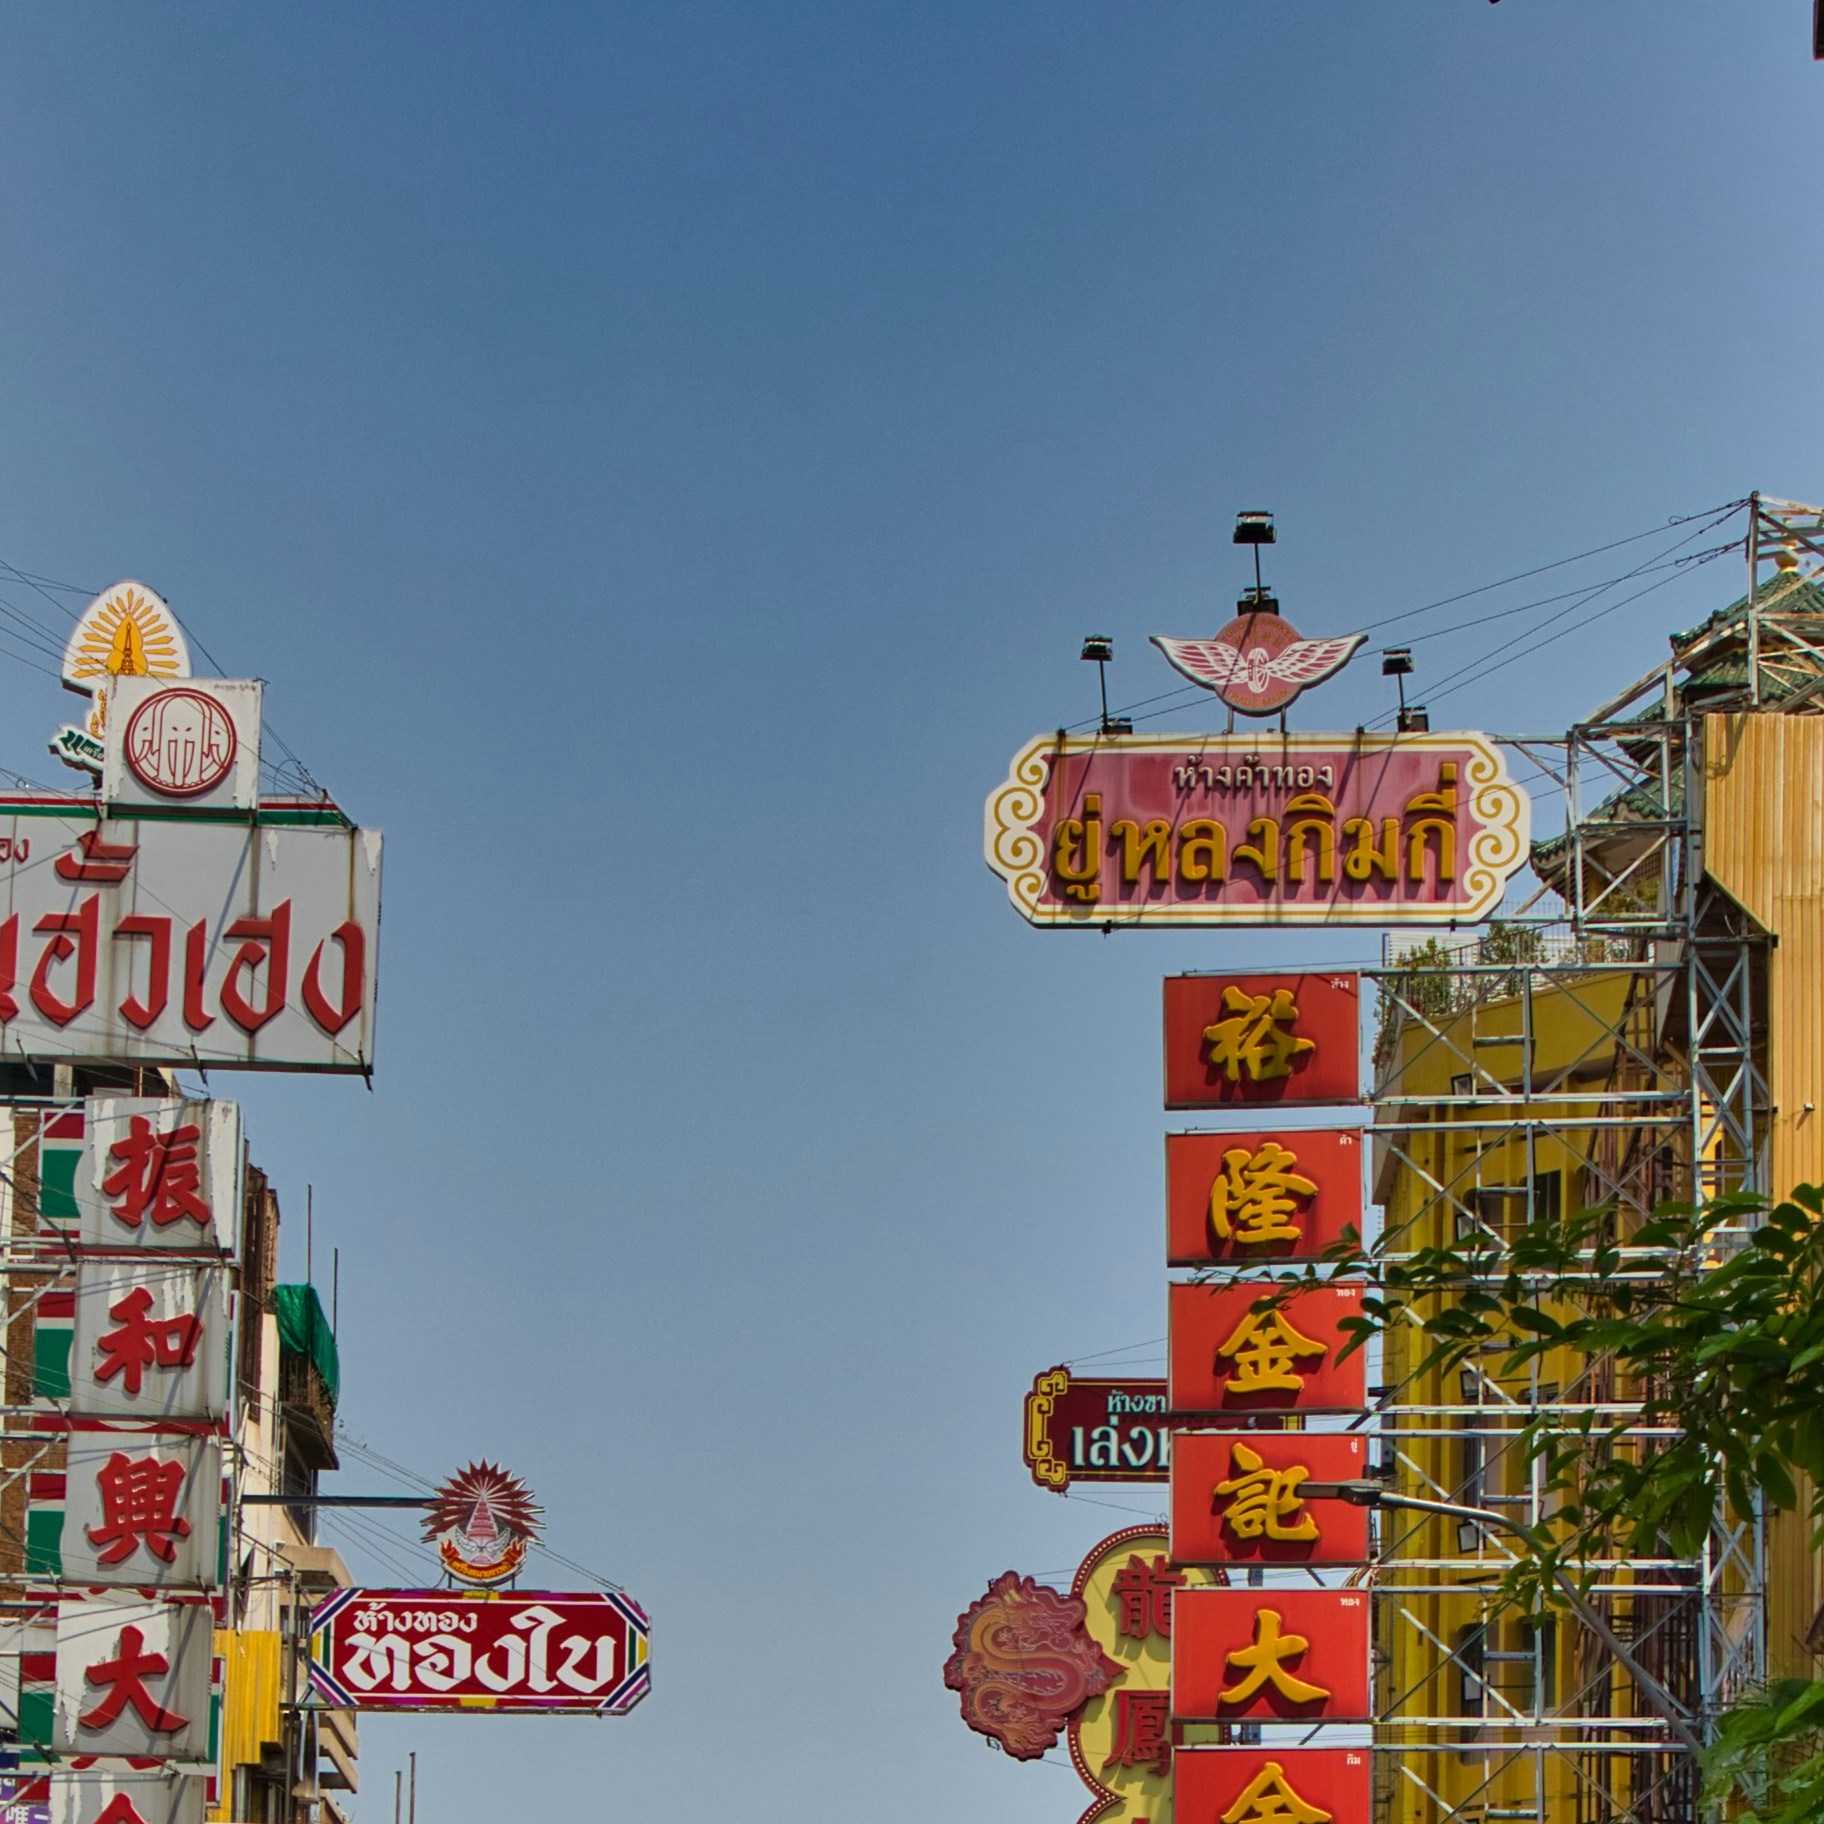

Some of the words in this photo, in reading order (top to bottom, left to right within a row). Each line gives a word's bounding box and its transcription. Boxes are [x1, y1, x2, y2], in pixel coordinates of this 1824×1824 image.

[1173, 753, 1335, 791] ห้างค้าทอง
[1053, 763, 1459, 902] ยู่หลงกิมกี่
[353, 1599, 478, 1632] ห้างทอง
[341, 1604, 616, 1695] ทองใบ
